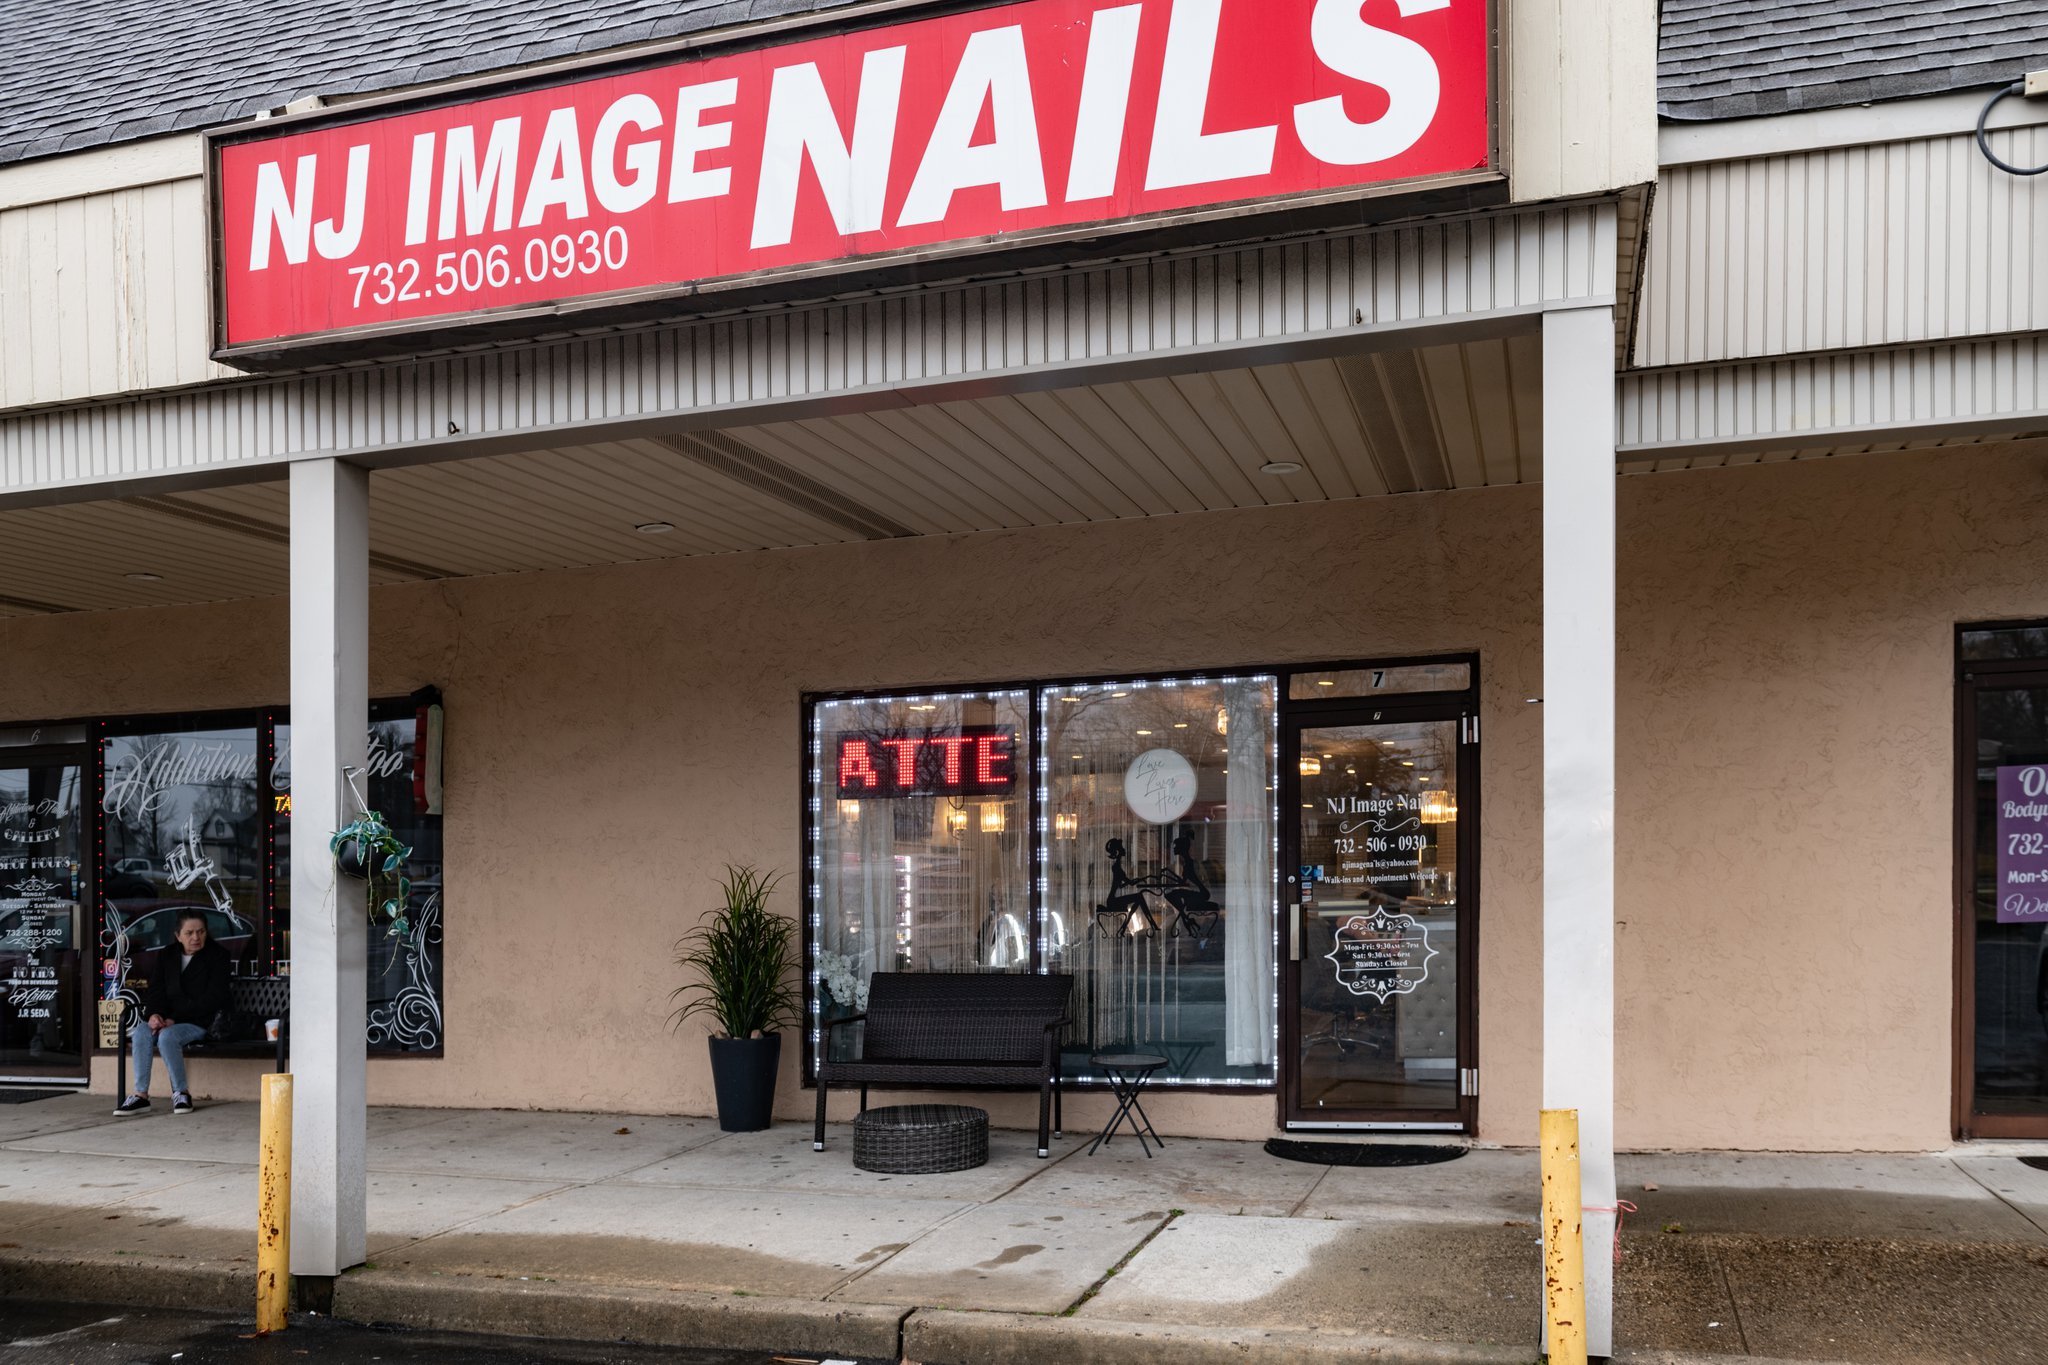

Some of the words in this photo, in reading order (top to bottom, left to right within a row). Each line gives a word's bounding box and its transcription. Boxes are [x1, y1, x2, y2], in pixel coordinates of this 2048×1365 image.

[249, 144, 370, 271] NJ
[404, 77, 738, 246] IMAGE
[749, 0, 1451, 250] NAILS
[347, 225, 629, 309] 732.506.0930
[1373, 671, 1384, 688] 7
[31, 728, 41, 743] 6
[840, 735, 1009, 787] ATTE
[102, 741, 258, 823] Addiction
[1326, 797, 1346, 815] NJ
[1350, 795, 1394, 817] Image
[4, 825, 61, 843] GALLERY
[1334, 838, 1355, 854] 732
[1366, 836, 1387, 853] 506
[1398, 834, 1427, 851] 0930
[1324, 876, 1352, 885] Walk-ins
[1365, 873, 1409, 885] Appointments
[1384, 959, 1408, 968] Closed
[30, 1008, 51, 1018] SEDA
